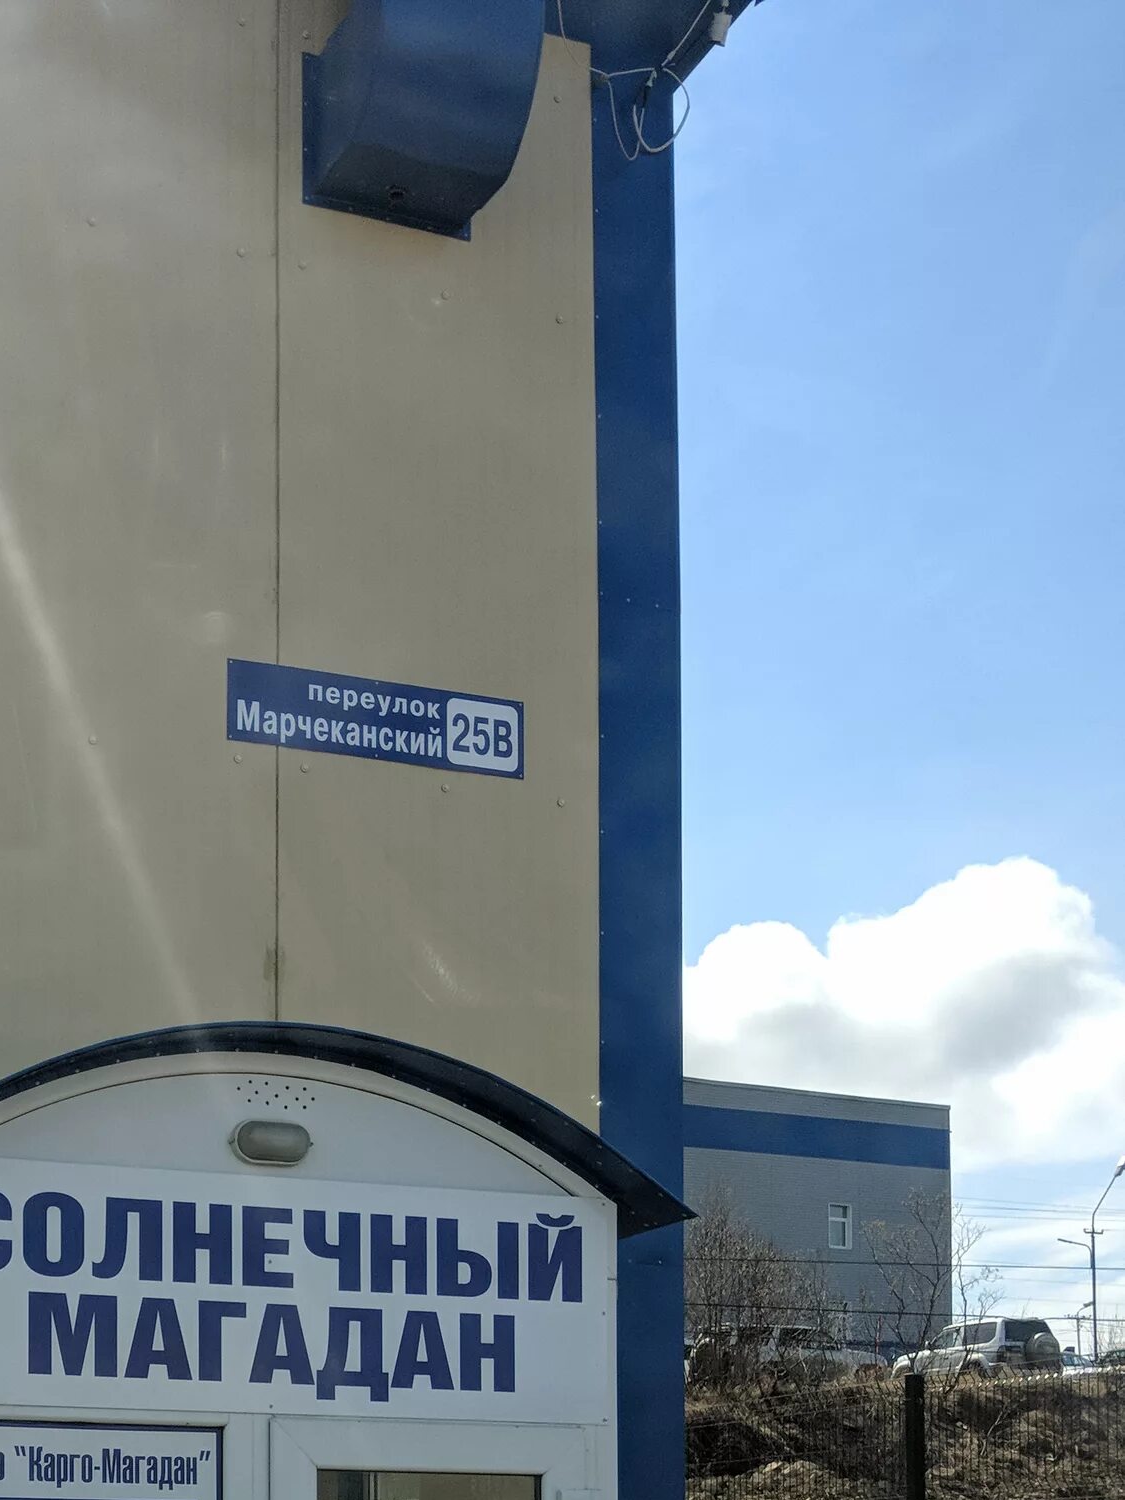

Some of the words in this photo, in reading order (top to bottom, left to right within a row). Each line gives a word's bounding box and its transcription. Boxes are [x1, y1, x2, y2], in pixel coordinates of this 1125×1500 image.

[236, 699, 442, 758] Марчеканский
[452, 713, 514, 758] 25В
[308, 684, 441, 720] переулок
[28, 1290, 515, 1403] МАГАДАН
